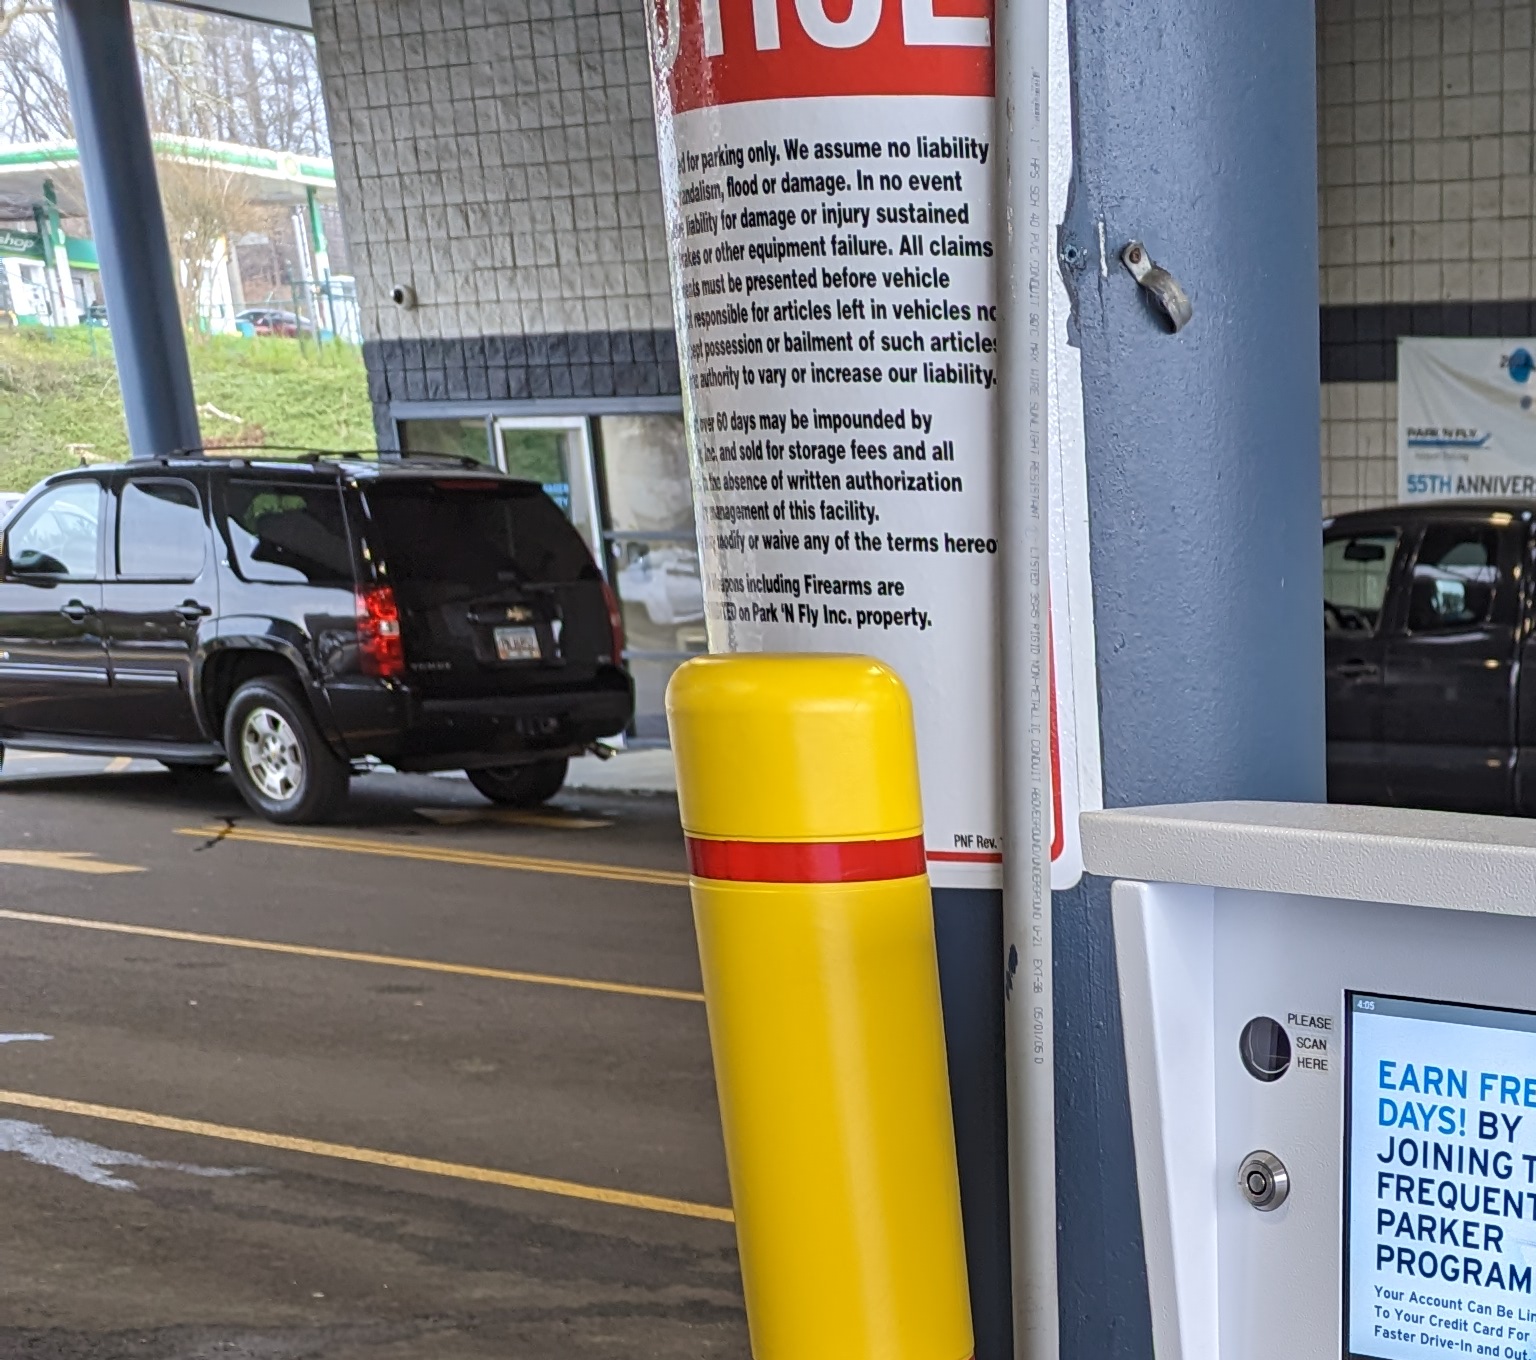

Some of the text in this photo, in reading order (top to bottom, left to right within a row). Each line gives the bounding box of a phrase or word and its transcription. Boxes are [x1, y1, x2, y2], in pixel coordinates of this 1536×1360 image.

[687, 150, 700, 173] for
[701, 144, 744, 175] parking
[748, 140, 780, 166] only.
[783, 138, 809, 160] We
[814, 141, 882, 159] assume
[888, 141, 911, 159] no
[916, 135, 990, 165] liability
[726, 169, 963, 198] flood or damage. In no event
[720, 209, 738, 231] for
[740, 206, 797, 231] damage
[801, 208, 817, 225] or
[821, 201, 871, 229] injury
[876, 202, 970, 225] sustained
[702, 233, 994, 265] or other equipment failure. All claims
[701, 273, 727, 297] must
[727, 271, 743, 294] be
[745, 267, 818, 297] presented
[821, 266, 878, 289] before
[881, 266, 951, 289] vehicle
[694, 298, 972, 332] responsible for articles left in vehicles
[704, 330, 925, 363] possession or bailment of such
[700, 361, 998, 390] authority to vary or increase our liability.
[716, 408, 933, 435] 60 days may be impounded by
[719, 438, 955, 465] and sold for storage fees and all
[723, 469, 963, 493] absence of written authorization
[1407, 473, 1452, 494] 55TH
[772, 499, 880, 526] of this facility.
[748, 529, 939, 555] or waive any of the terms
[745, 573, 906, 598] including Firearms are
[739, 606, 751, 621] on
[752, 602, 779, 624] Park
[798, 603, 820, 629] Fly
[823, 604, 853, 625] Inc.
[856, 606, 933, 631] property.
[953, 833, 998, 850] PNF Rev.
[1357, 1000, 1375, 1011] 4:05
[1287, 1012, 1332, 1030] PLEASE
[1296, 1036, 1327, 1051] SCAN
[1297, 1057, 1329, 1071] HERE
[1378, 1059, 1468, 1100] EARN
[1378, 1097, 1523, 1144] DAYS! BY
[1376, 1136, 1513, 1181] JOINING
[1376, 1207, 1504, 1254] PARKER
[1376, 1243, 1533, 1295] PROGRAM
[1374, 1284, 1405, 1302] Your
[1408, 1290, 1463, 1312] Account
[1467, 1299, 1492, 1316] Can
[1496, 1304, 1514, 1319] Be
[1374, 1304, 1530, 1343] To Your Credit Card For
[1374, 1325, 1416, 1344] Faster
[1420, 1332, 1473, 1353] Drive-In
[1476, 1342, 1500, 1358] and
